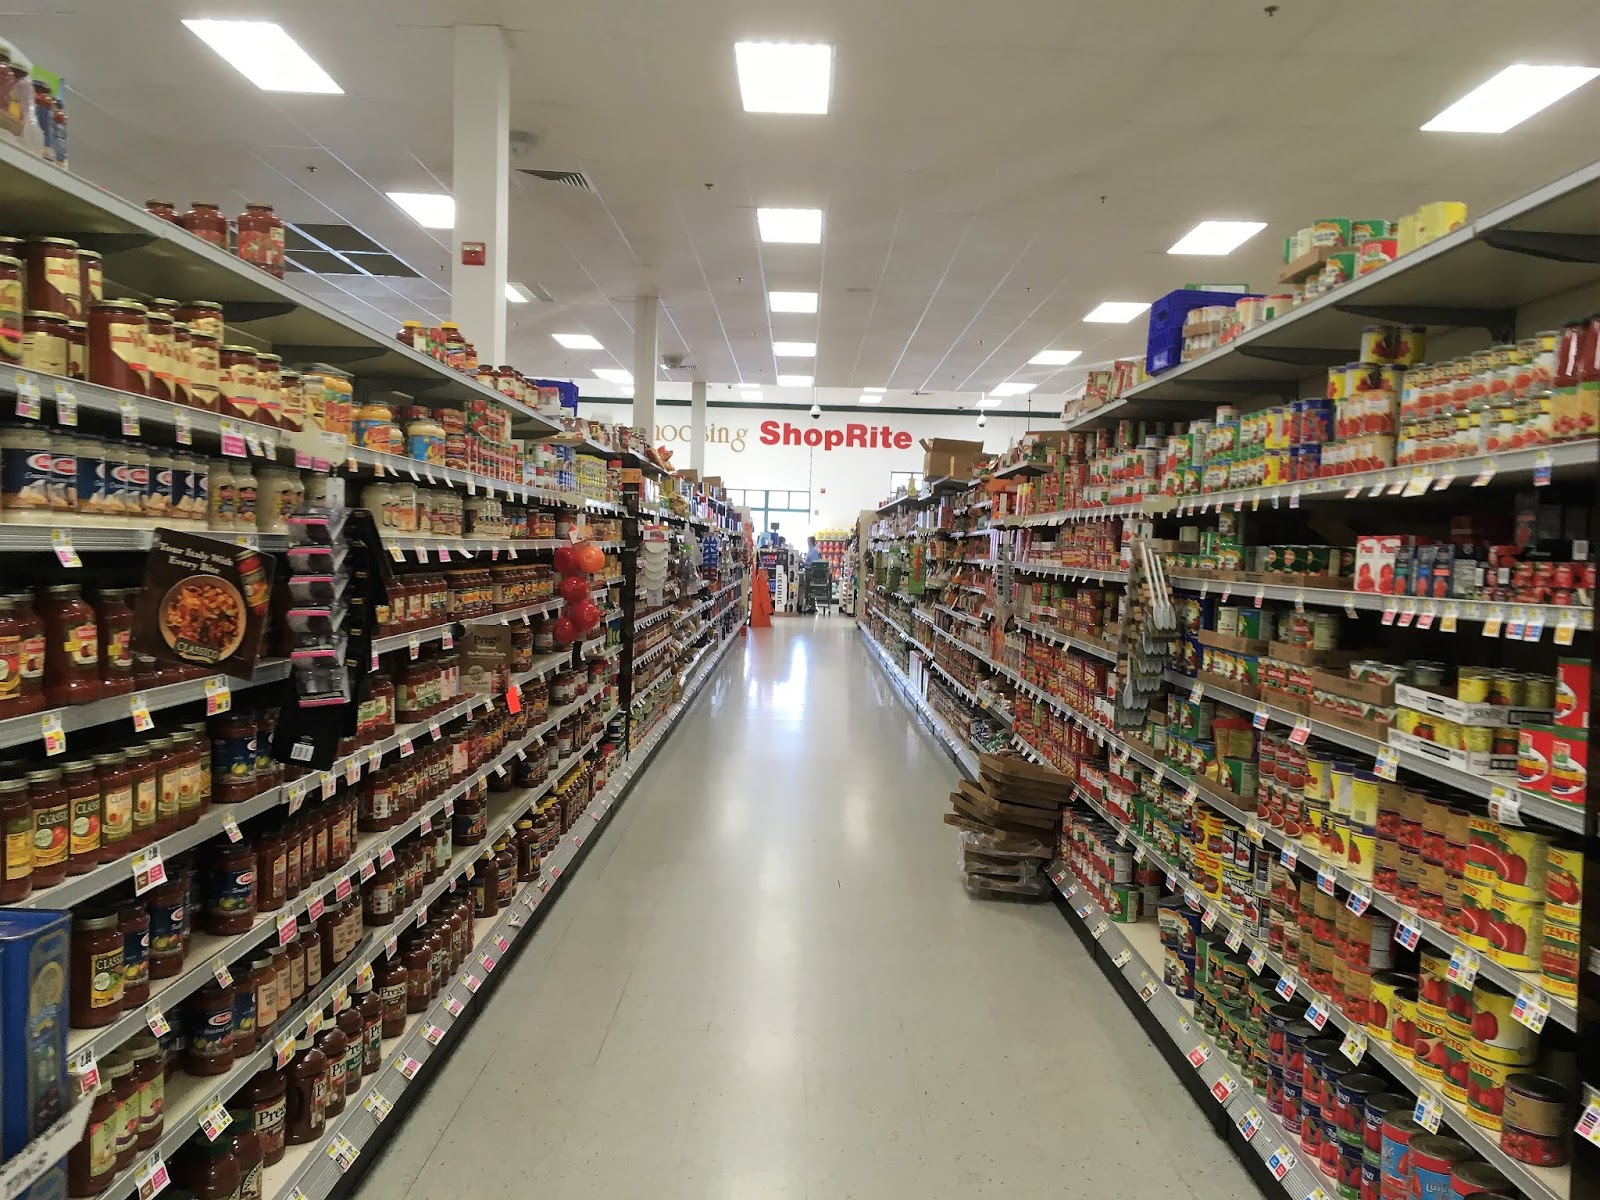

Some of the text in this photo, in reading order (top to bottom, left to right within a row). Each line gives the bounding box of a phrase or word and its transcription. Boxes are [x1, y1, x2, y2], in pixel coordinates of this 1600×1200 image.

[655, 420, 912, 453] ooing ShopRite
[168, 555, 199, 571] Every
[185, 547, 210, 562] Italy
[210, 553, 234, 567] With
[474, 635, 501, 646] Prego
[178, 641, 219, 659] CLASSICO
